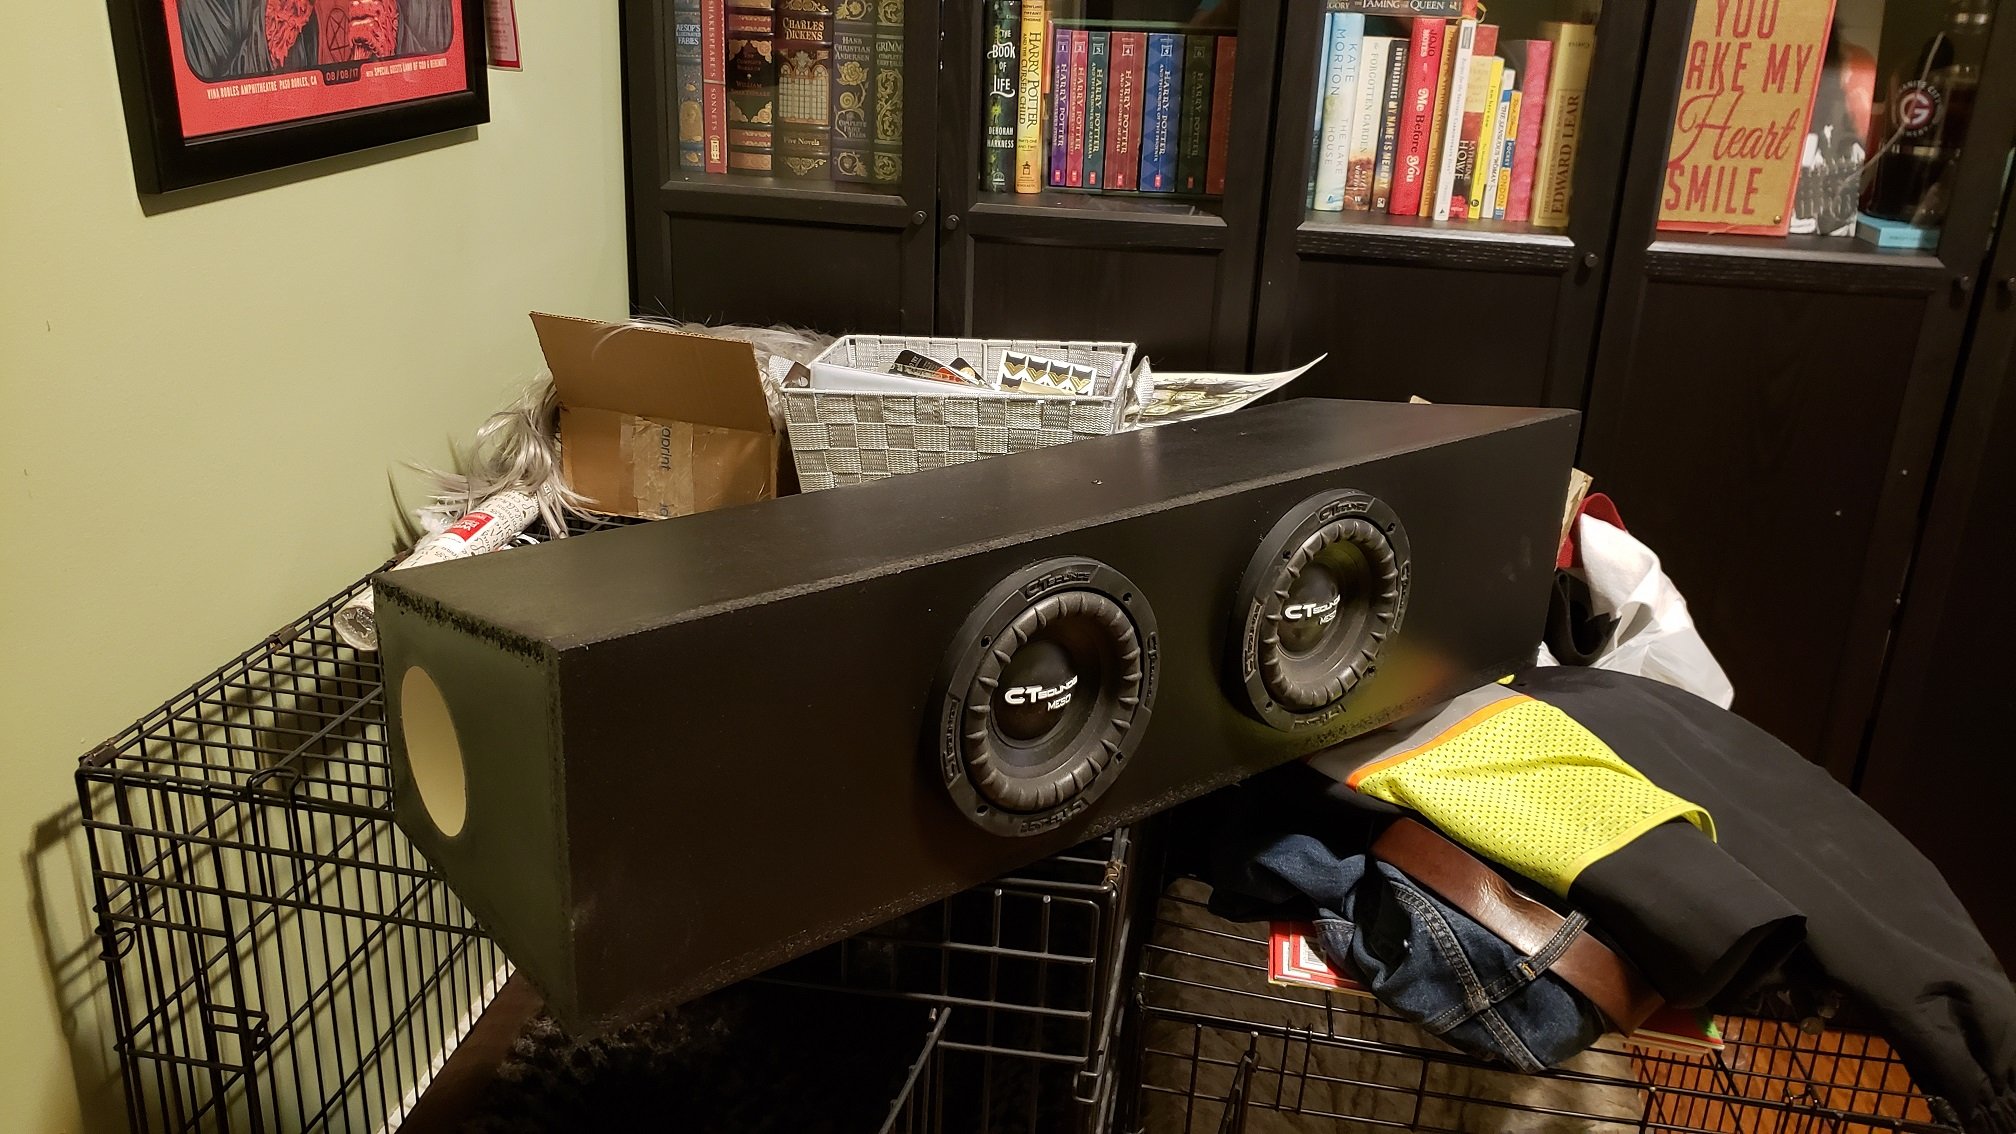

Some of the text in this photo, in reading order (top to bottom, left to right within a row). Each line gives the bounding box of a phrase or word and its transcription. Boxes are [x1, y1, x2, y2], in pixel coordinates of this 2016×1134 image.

[1327, 0, 1349, 9] GORY
[1410, 0, 1444, 11] QUEEN
[782, 17, 824, 31] CHARLES
[1715, 0, 1779, 38] YOU
[678, 37, 699, 45] FABLES
[786, 30, 823, 41] DICKENS
[842, 36, 863, 44] HANS
[1001, 30, 1011, 38] THE
[1420, 29, 1431, 58] MOYES
[1428, 29, 1437, 57] JOJO
[834, 44, 870, 53] CHRISTIAN
[835, 52, 870, 61] ANDERSEN
[987, 42, 1015, 59] BOOK
[1330, 28, 1346, 96] MORTON
[999, 62, 1007, 72] OF
[1345, 43, 1358, 83] KATE
[1686, 40, 1813, 93] AKE MY
[310, 75, 317, 86] CA
[990, 75, 1015, 97] LIFE
[1027, 32, 1041, 129] HARRY POTTER
[1058, 63, 1068, 146] HARRY POTTER
[1093, 69, 1103, 152] HARRY POTTER
[1121, 70, 1132, 154] HARRY POTTER
[1159, 71, 1171, 154] HARRY POTTER
[1360, 53, 1378, 153] FORGOTTEN GARDEN
[1388, 101, 1398, 114] MY
[1415, 88, 1430, 112] Me
[1900, 93, 1929, 124] G
[798, 138, 820, 146] Novels
[988, 127, 1014, 136] DEBORAH
[1385, 116, 1396, 140] NAME
[1410, 115, 1425, 153] Before
[1668, 92, 1800, 164] Heart
[1324, 126, 1336, 165] HOUSE
[1384, 142, 1393, 151] IS
[1504, 142, 1512, 166] POCKET
[1552, 96, 1578, 213] EDWARD LEAR
[1336, 145, 1347, 176] LAKE
[1379, 153, 1391, 189] MEMORY
[1405, 155, 1420, 183] You
[1464, 140, 1476, 181] KATHERINE
[1498, 169, 1509, 207] LONDON
[1665, 162, 1763, 215] SMILE
[1047, 693, 1071, 712] MESO
